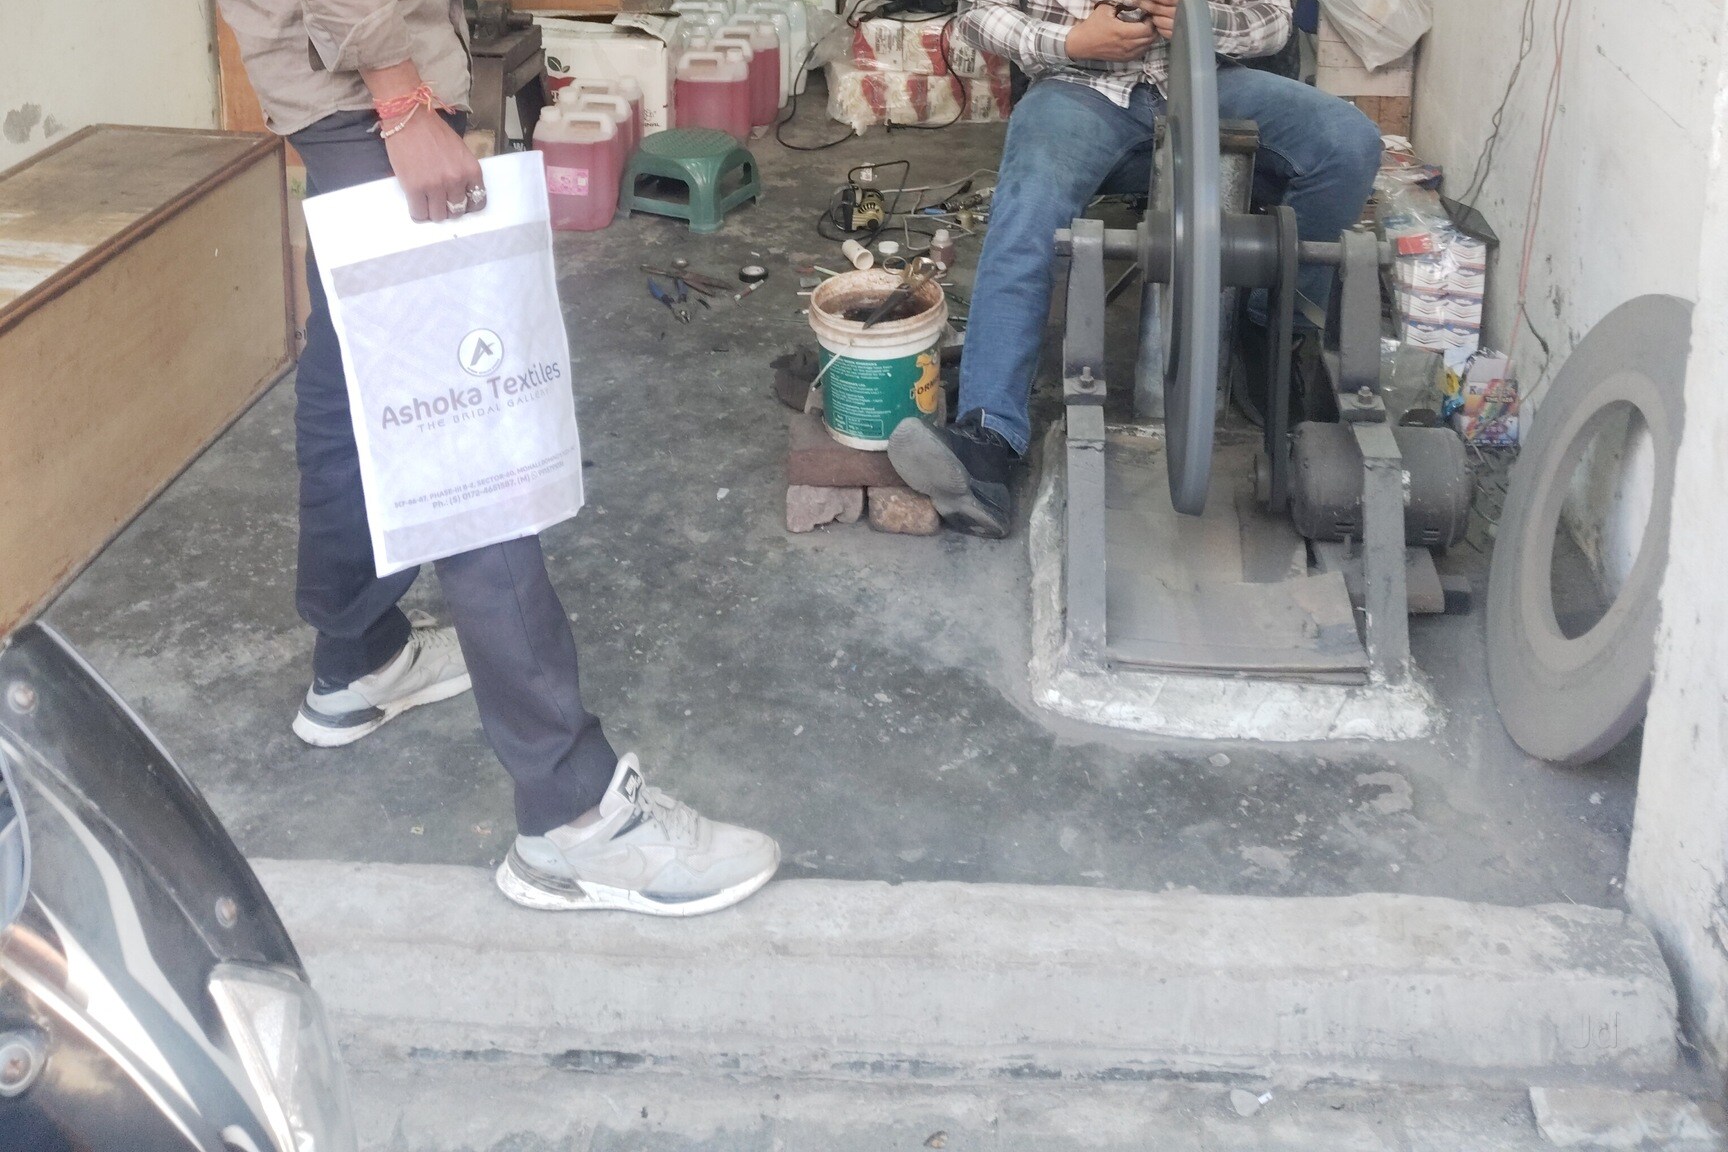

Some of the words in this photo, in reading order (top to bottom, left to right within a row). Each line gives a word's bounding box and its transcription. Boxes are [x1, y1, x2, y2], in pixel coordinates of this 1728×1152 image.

[381, 387, 482, 430] Ashoka
[487, 361, 562, 399] Textiles
[417, 418, 446, 433] THE
[452, 403, 501, 424] BRIDAL
